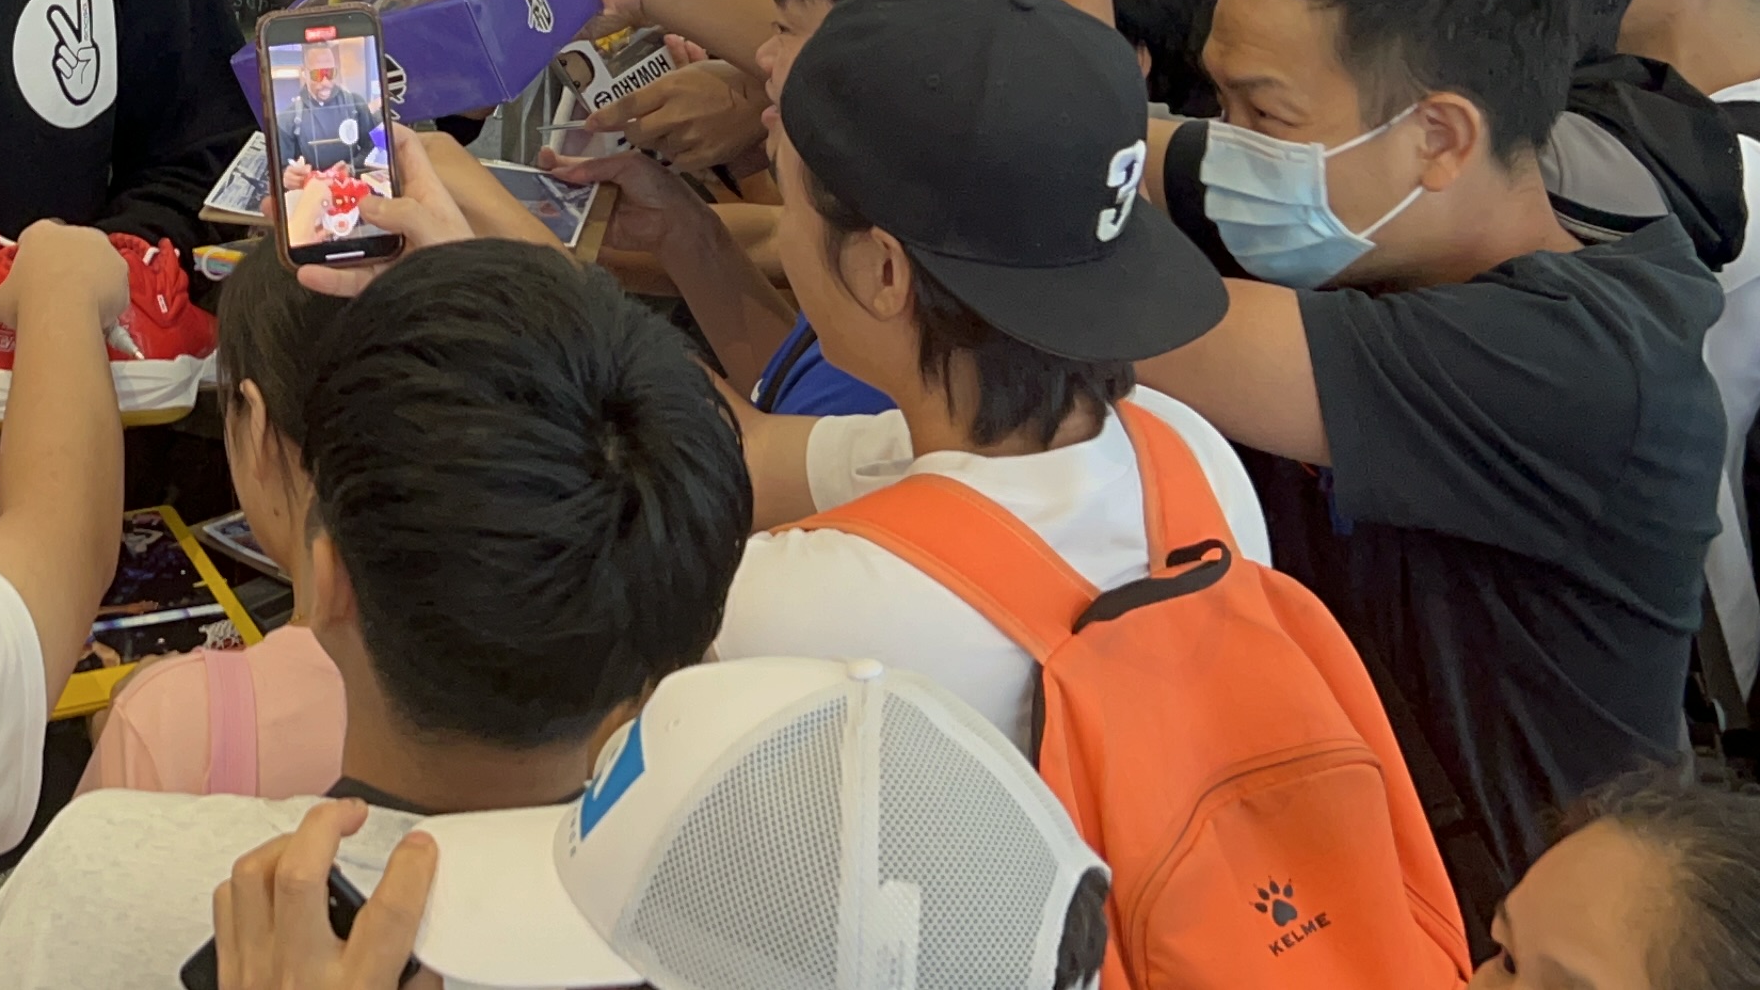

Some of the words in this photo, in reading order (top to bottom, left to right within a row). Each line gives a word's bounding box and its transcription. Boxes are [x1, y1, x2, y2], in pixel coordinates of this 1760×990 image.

[611, 53, 672, 99] HOWARD
[1096, 139, 1147, 242] 3
[1268, 911, 1331, 957] KELME
